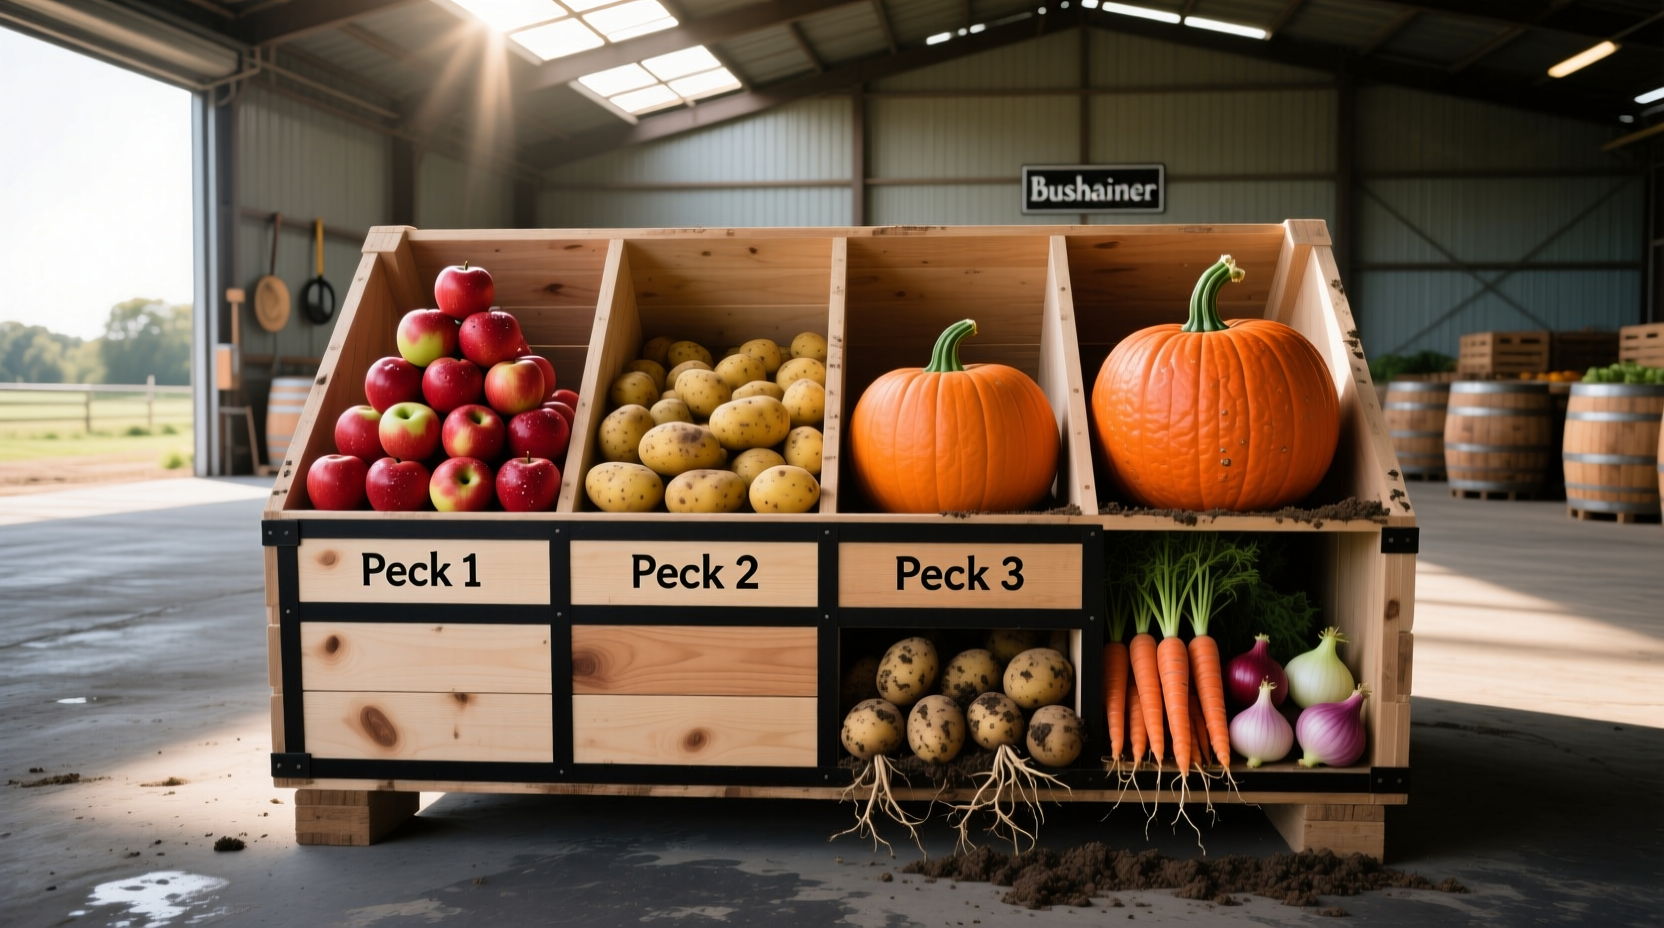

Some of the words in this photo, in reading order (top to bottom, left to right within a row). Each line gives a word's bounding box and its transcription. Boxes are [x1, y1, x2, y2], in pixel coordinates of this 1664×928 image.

[1031, 175, 1157, 202] Bushainer
[361, 550, 453, 588] Peck
[462, 552, 481, 588] 1
[631, 553, 725, 590] Peck
[735, 554, 759, 590] 2
[895, 554, 991, 592] Peck
[1000, 555, 1025, 592] 3
